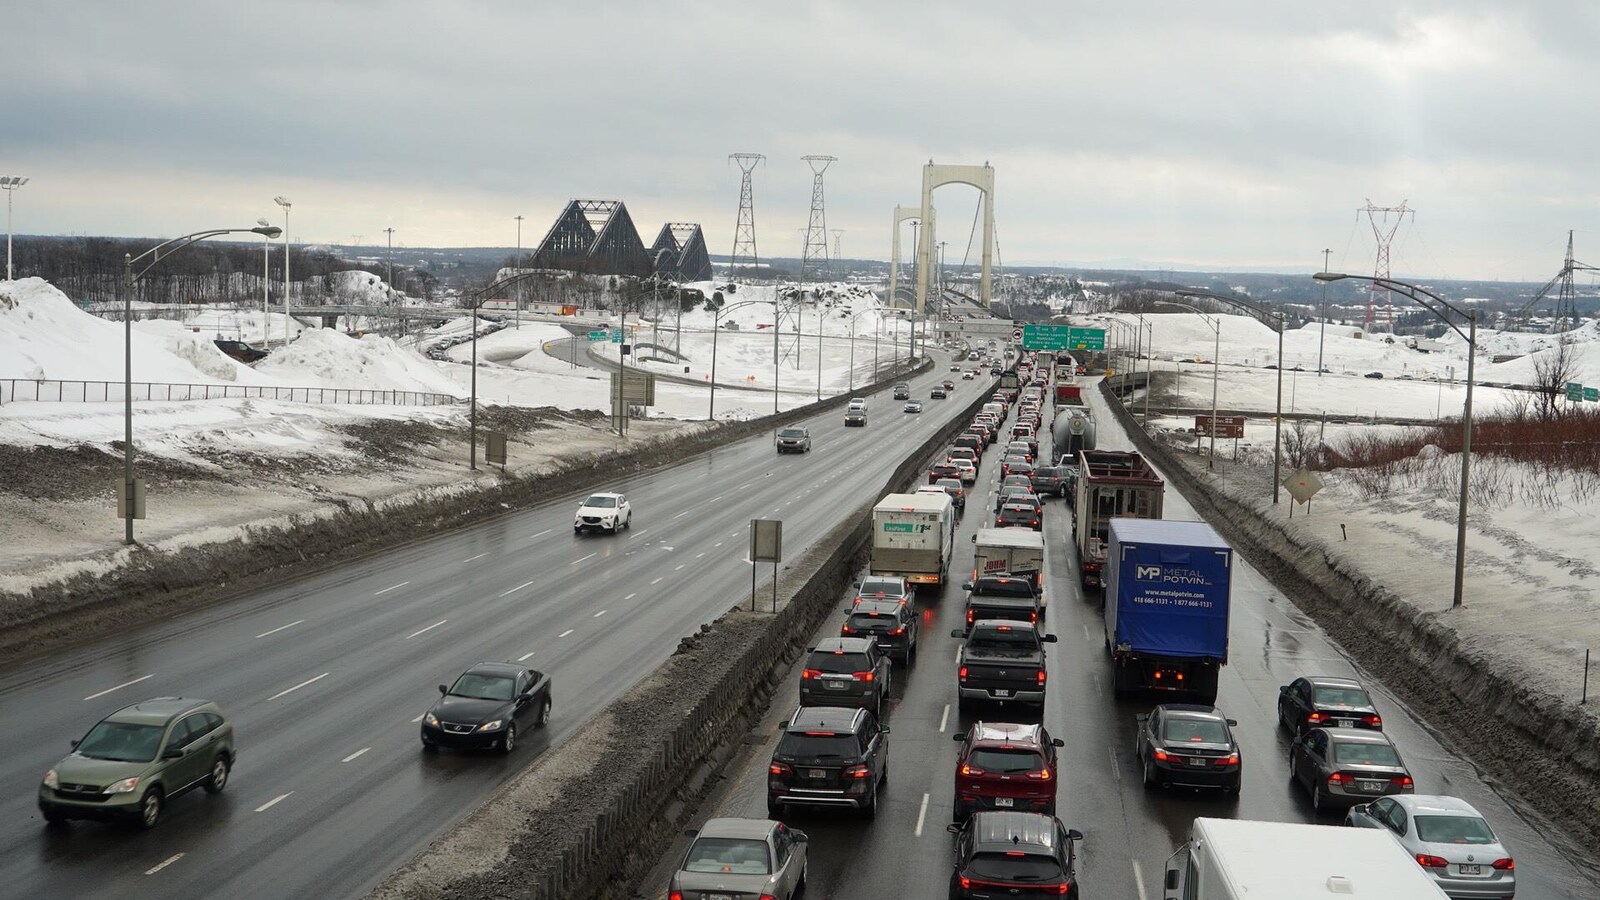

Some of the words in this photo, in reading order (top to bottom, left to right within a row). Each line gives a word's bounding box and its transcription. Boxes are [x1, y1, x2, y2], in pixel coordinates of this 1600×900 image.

[1137, 566, 1160, 579] MP
[1163, 575, 1205, 585] POTVIN
[1145, 590, 1205, 599] www.metalpotvin.com
[1144, 597, 1168, 605] 666-1131
[1188, 600, 1213, 608] 666-1131
